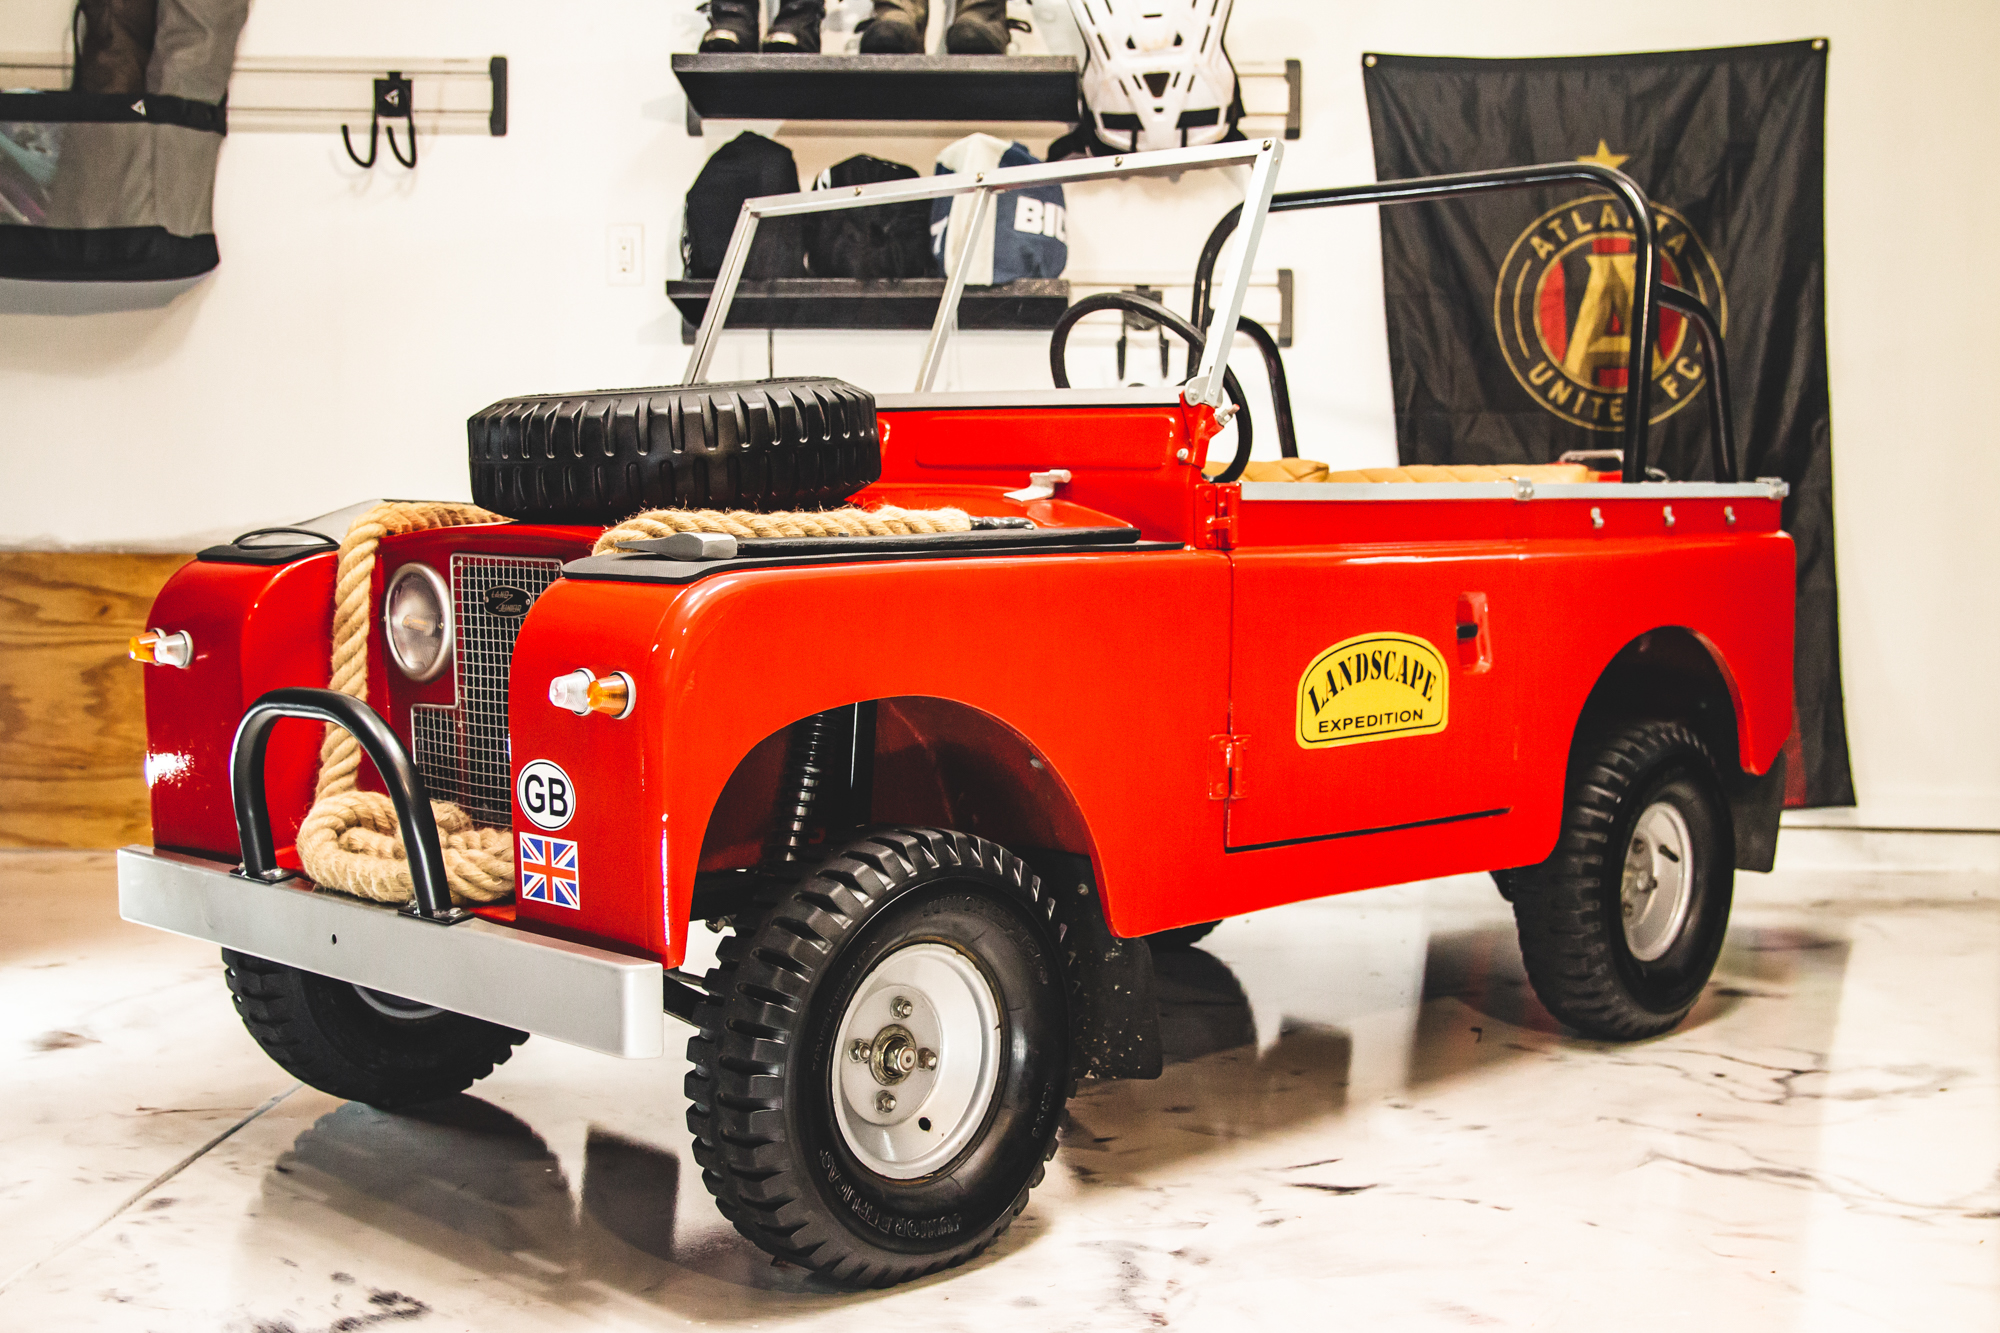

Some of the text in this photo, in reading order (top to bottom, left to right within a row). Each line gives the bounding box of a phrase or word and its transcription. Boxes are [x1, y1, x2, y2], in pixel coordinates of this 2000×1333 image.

[1530, 205, 1687, 259] ATLATA
[1528, 356, 1700, 421] UNITE FC
[1308, 650, 1437, 717] LANDSCAPE
[1318, 709, 1423, 734] EXPEDITION
[524, 773, 568, 818] GB
